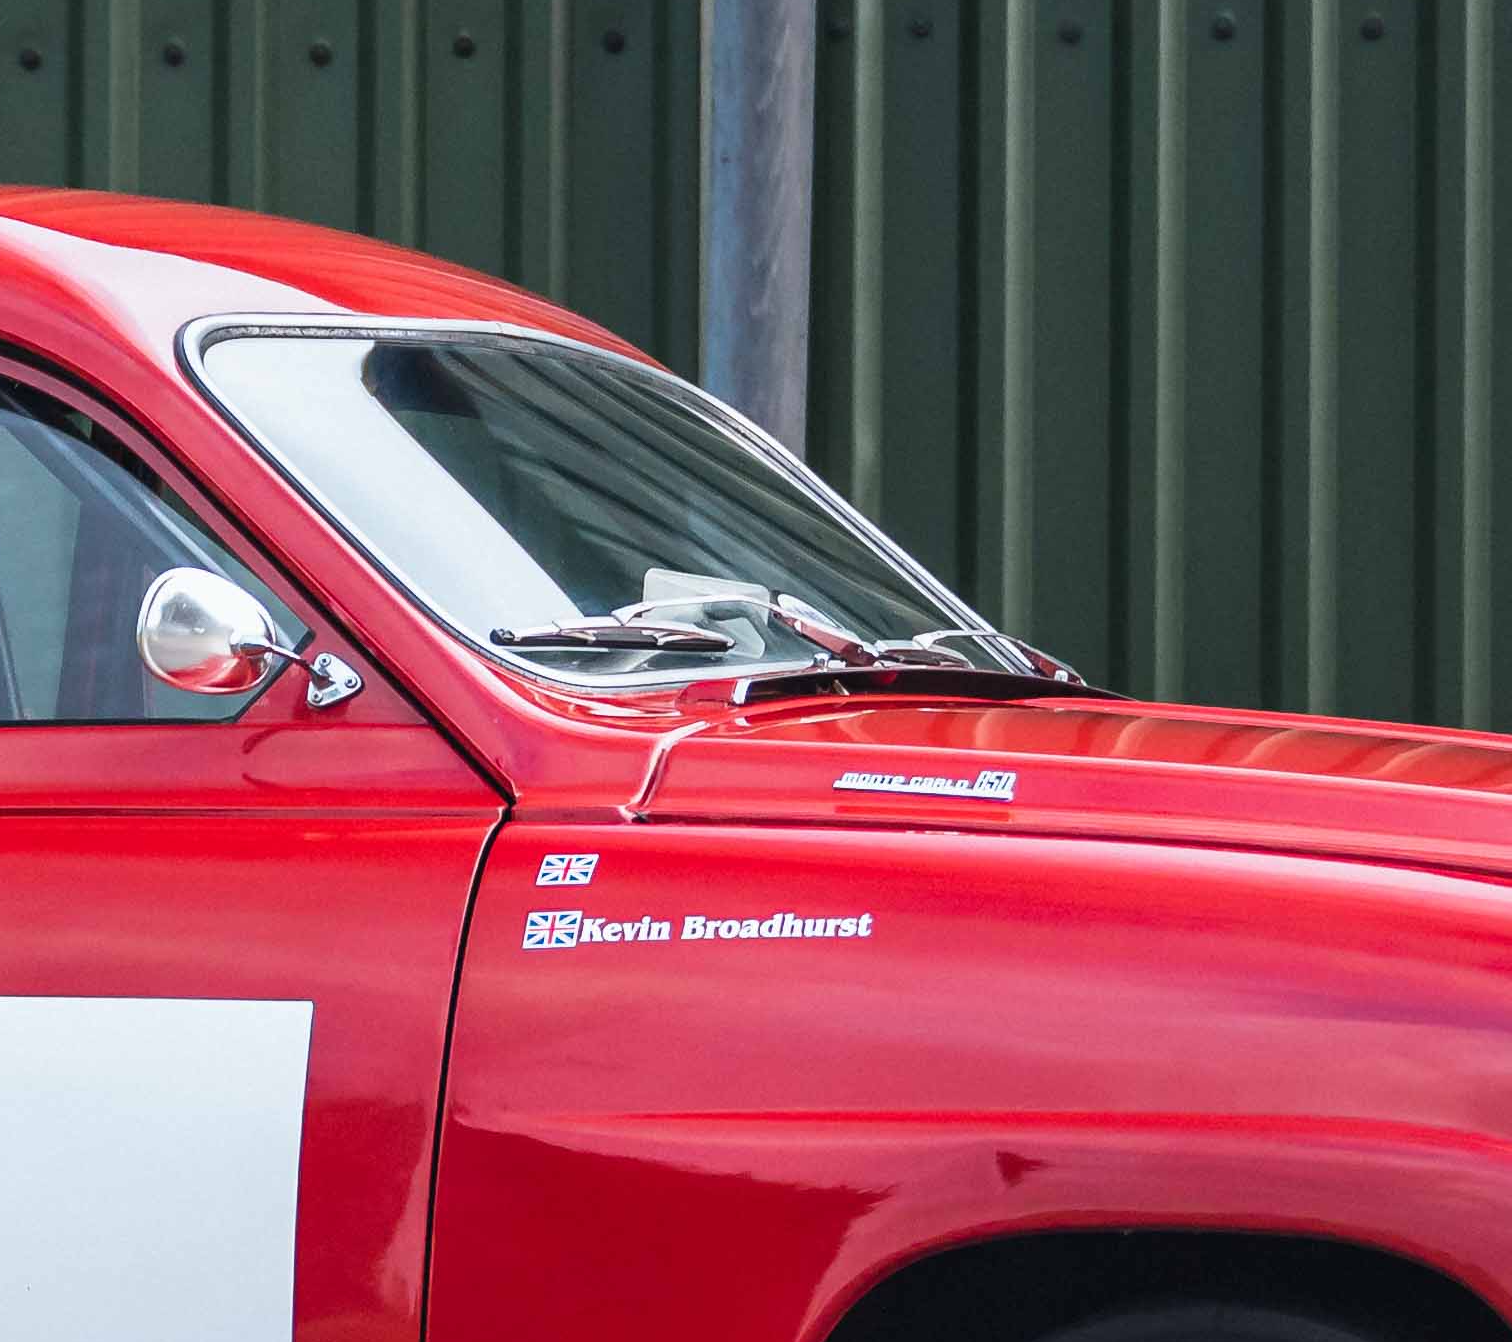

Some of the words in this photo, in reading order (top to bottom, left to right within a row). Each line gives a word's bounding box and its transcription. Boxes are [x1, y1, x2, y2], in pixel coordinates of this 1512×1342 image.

[973, 769, 1017, 793] 850
[579, 916, 672, 943] Kevin
[680, 912, 873, 940] Broadhurst
